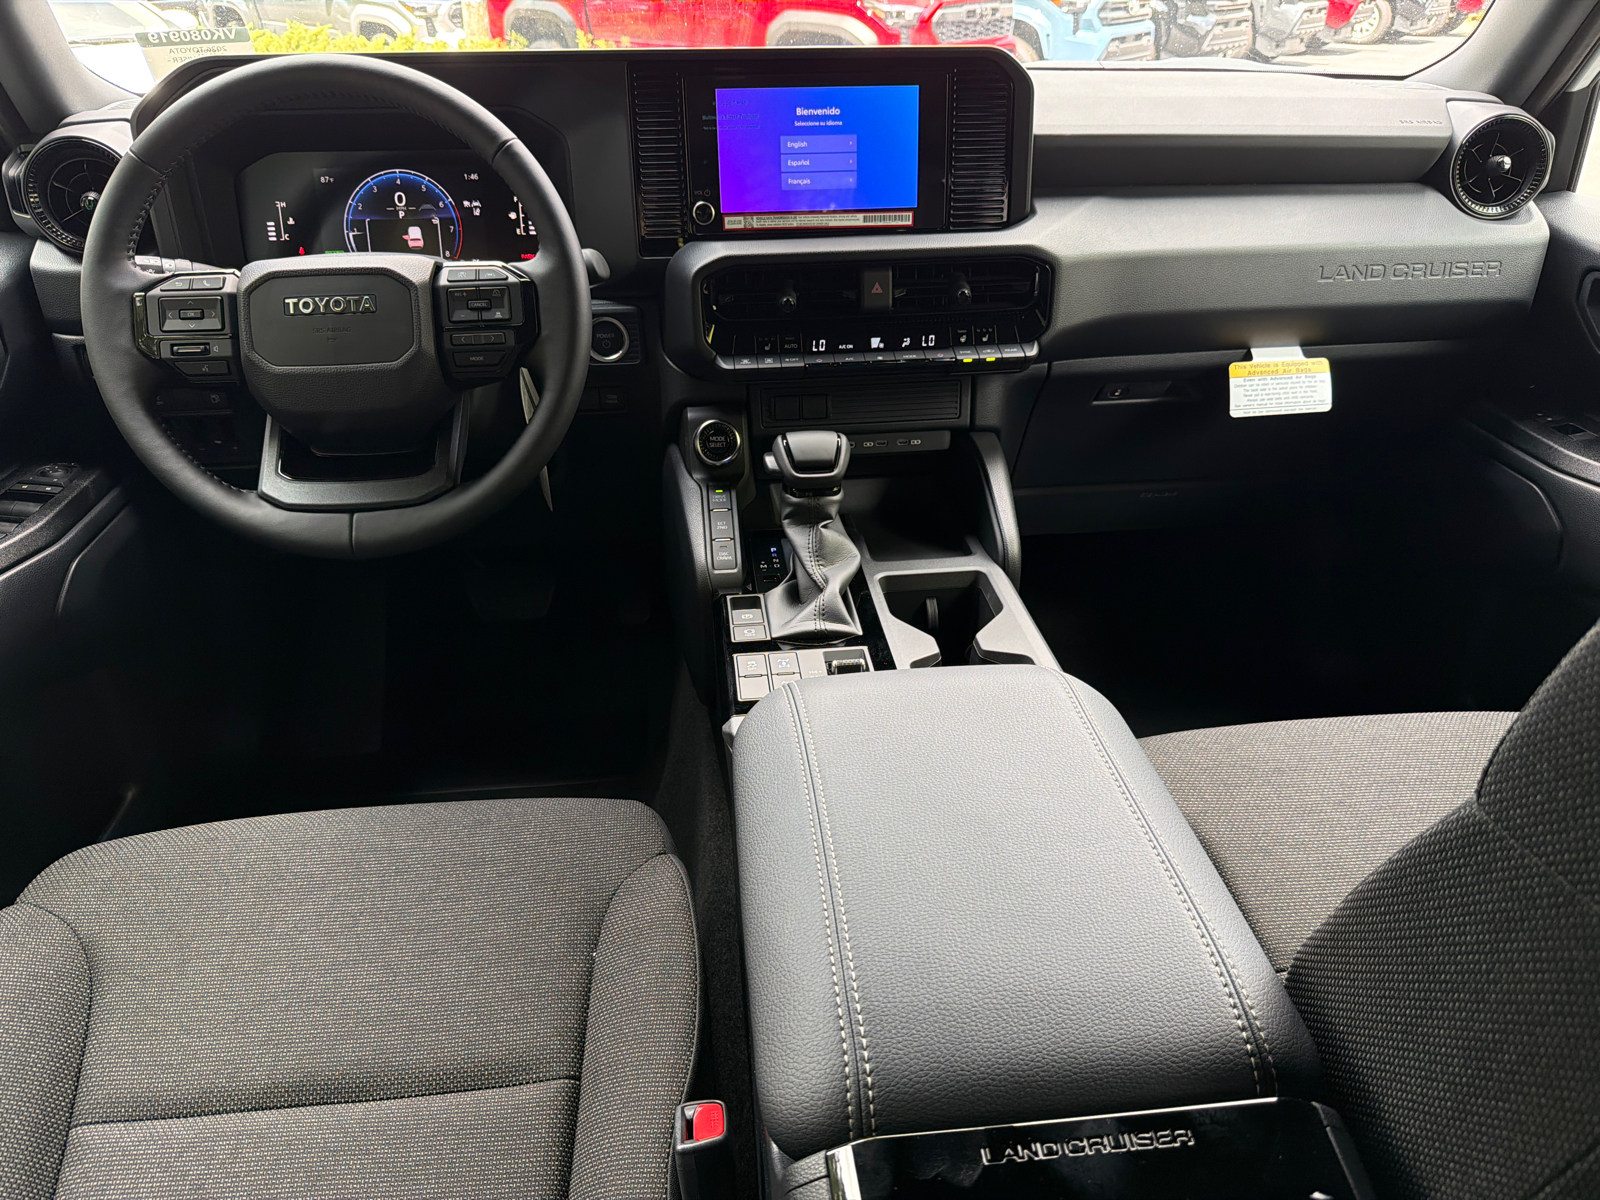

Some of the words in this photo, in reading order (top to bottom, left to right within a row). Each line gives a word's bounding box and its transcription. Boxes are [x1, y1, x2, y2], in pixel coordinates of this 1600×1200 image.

[796, 106, 840, 116] Bienvenido
[394, 192, 406, 206] 0
[398, 211, 405, 219] P
[1317, 264, 1386, 282] LAND
[1391, 261, 1502, 280] CRUISER
[285, 296, 376, 314] TOYOTA
[981, 1142, 1062, 1165] LAND
[1065, 1129, 1195, 1156] CRUISER
